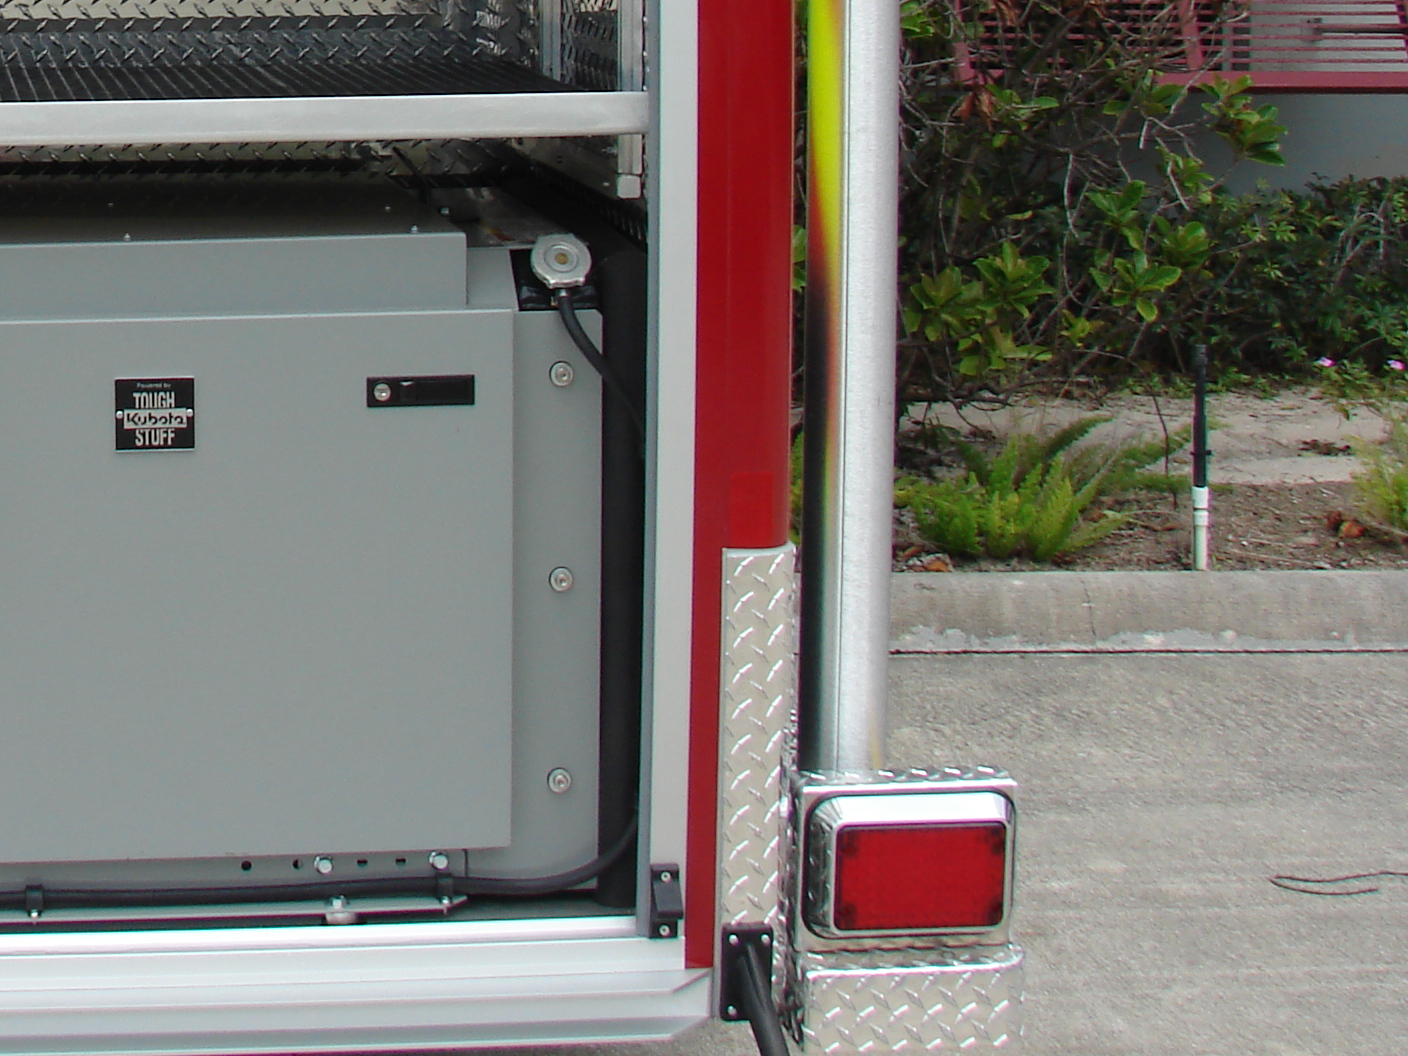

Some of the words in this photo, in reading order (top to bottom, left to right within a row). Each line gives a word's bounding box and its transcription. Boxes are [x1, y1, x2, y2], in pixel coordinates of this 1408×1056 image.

[133, 391, 175, 409] TOUGH
[126, 411, 186, 426] Kubota
[135, 428, 176, 447] STUFF
